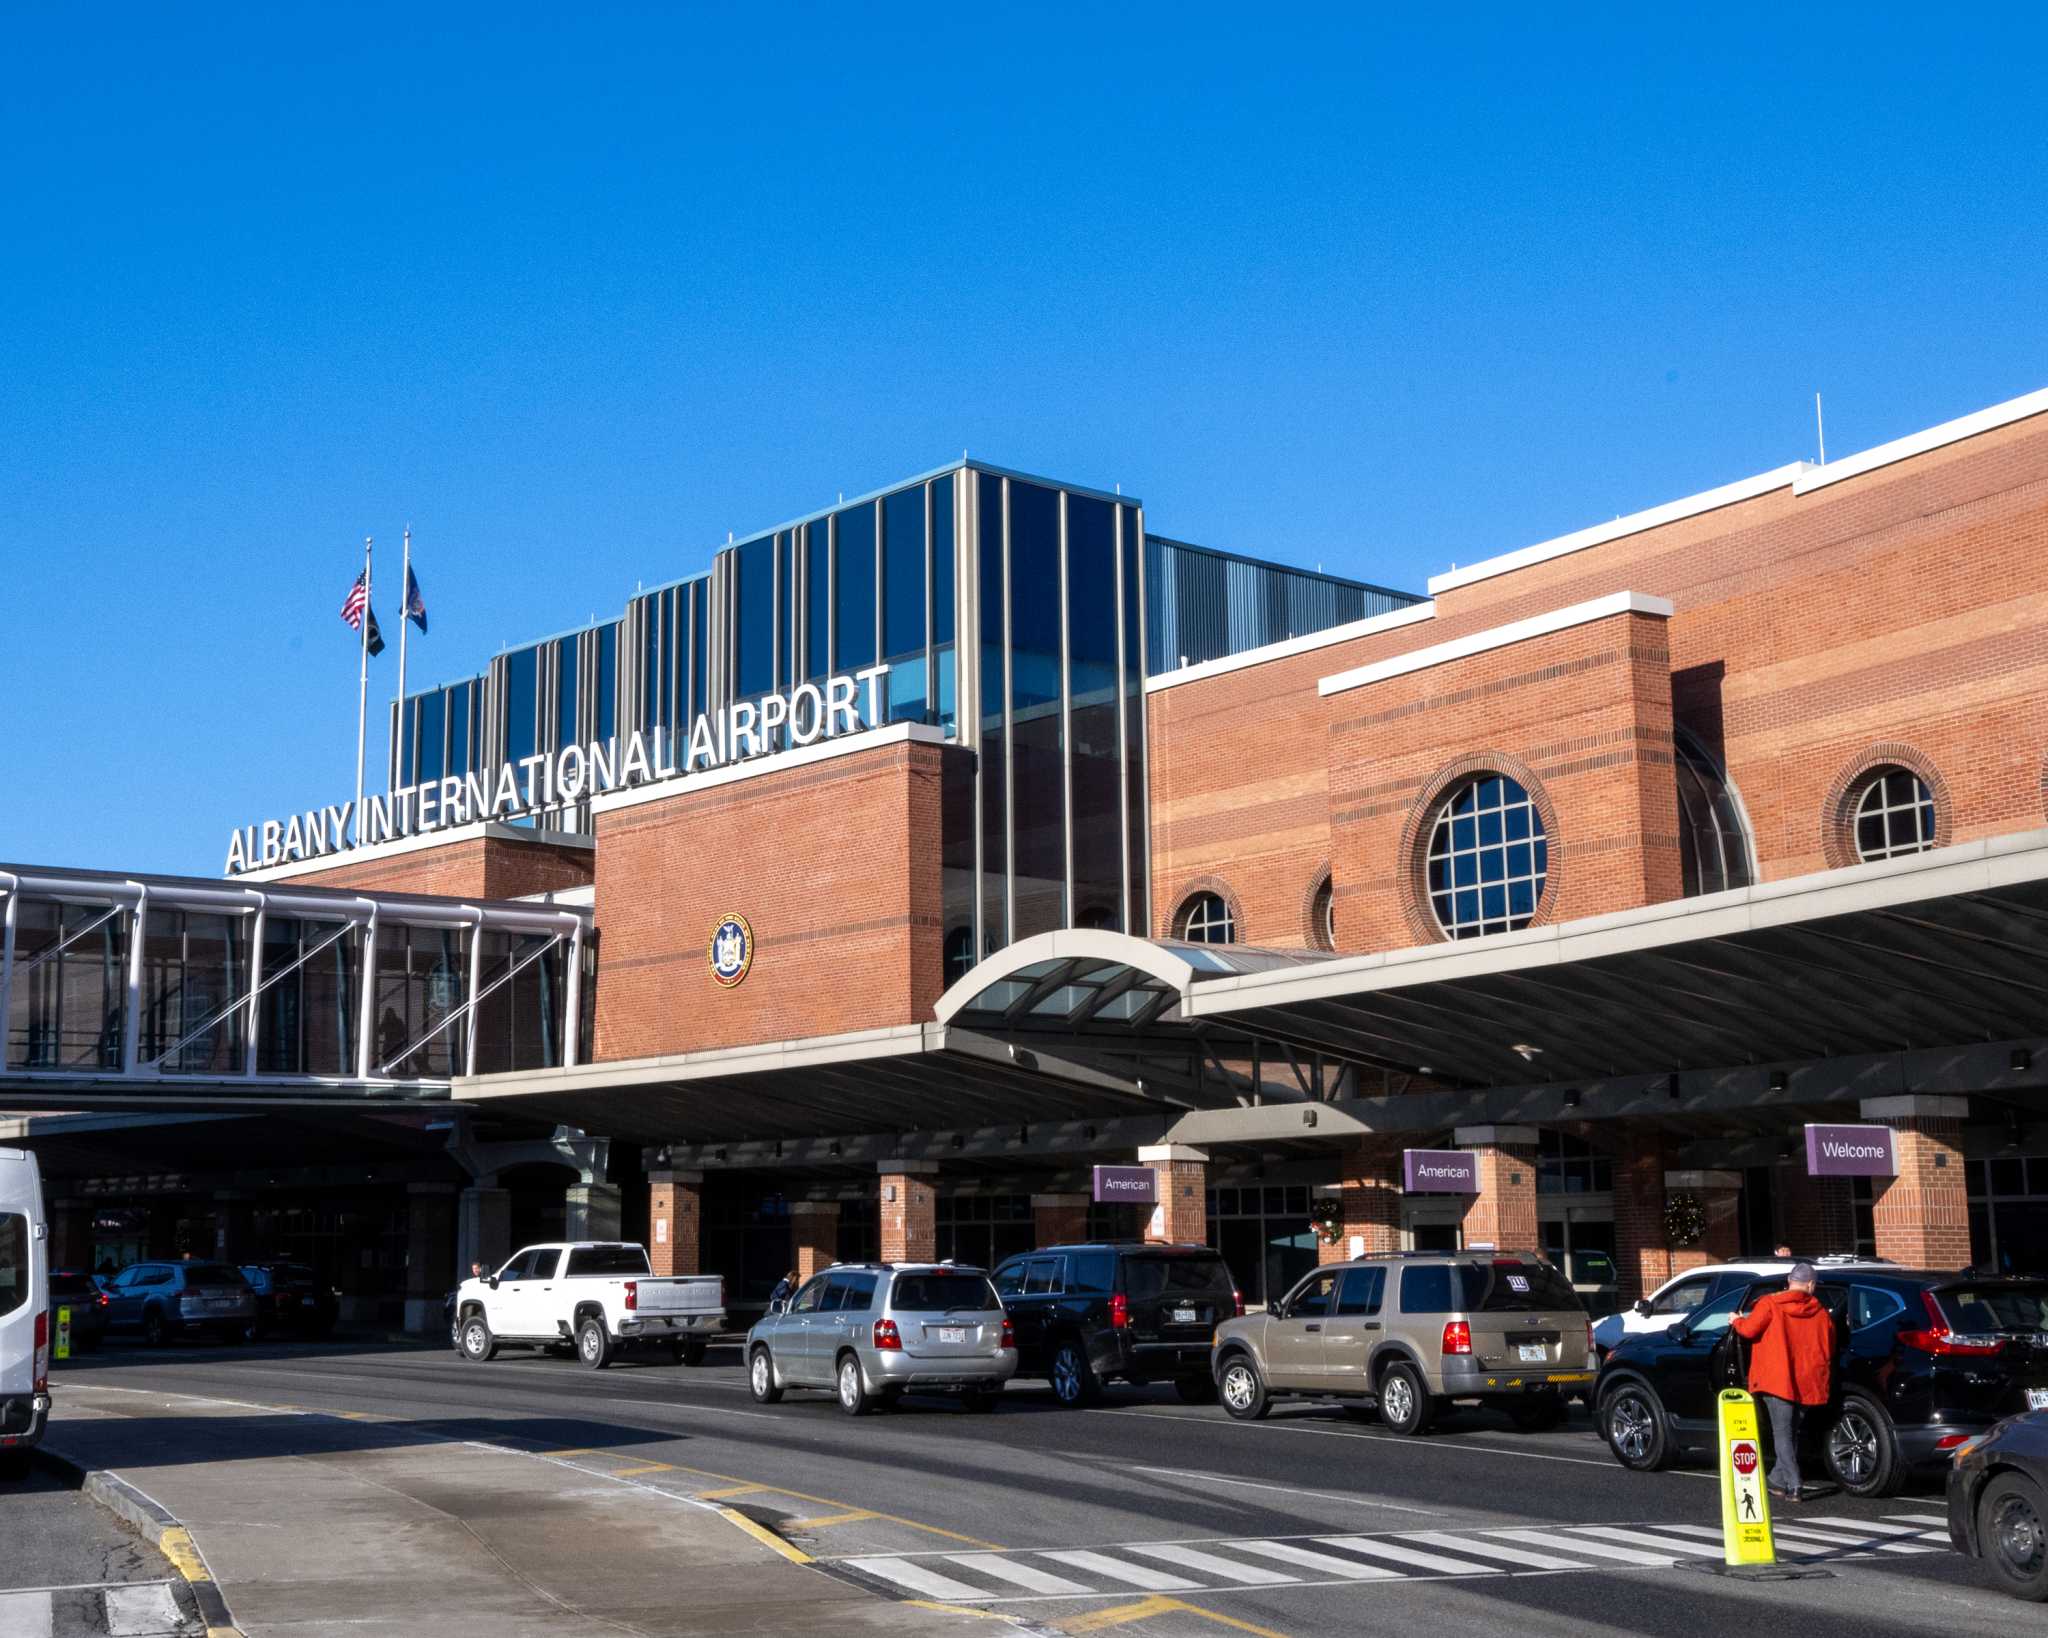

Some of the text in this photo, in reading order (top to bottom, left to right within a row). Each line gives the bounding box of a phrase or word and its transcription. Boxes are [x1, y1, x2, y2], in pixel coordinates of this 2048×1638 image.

[224, 663, 890, 875] ALBANY INTERNATIONAL AIRPORT
[1822, 1141, 1885, 1158] Welcome
[1418, 1164, 1470, 1178] American
[1105, 1178, 1150, 1190] American
[1734, 1452, 1756, 1465] STOP
